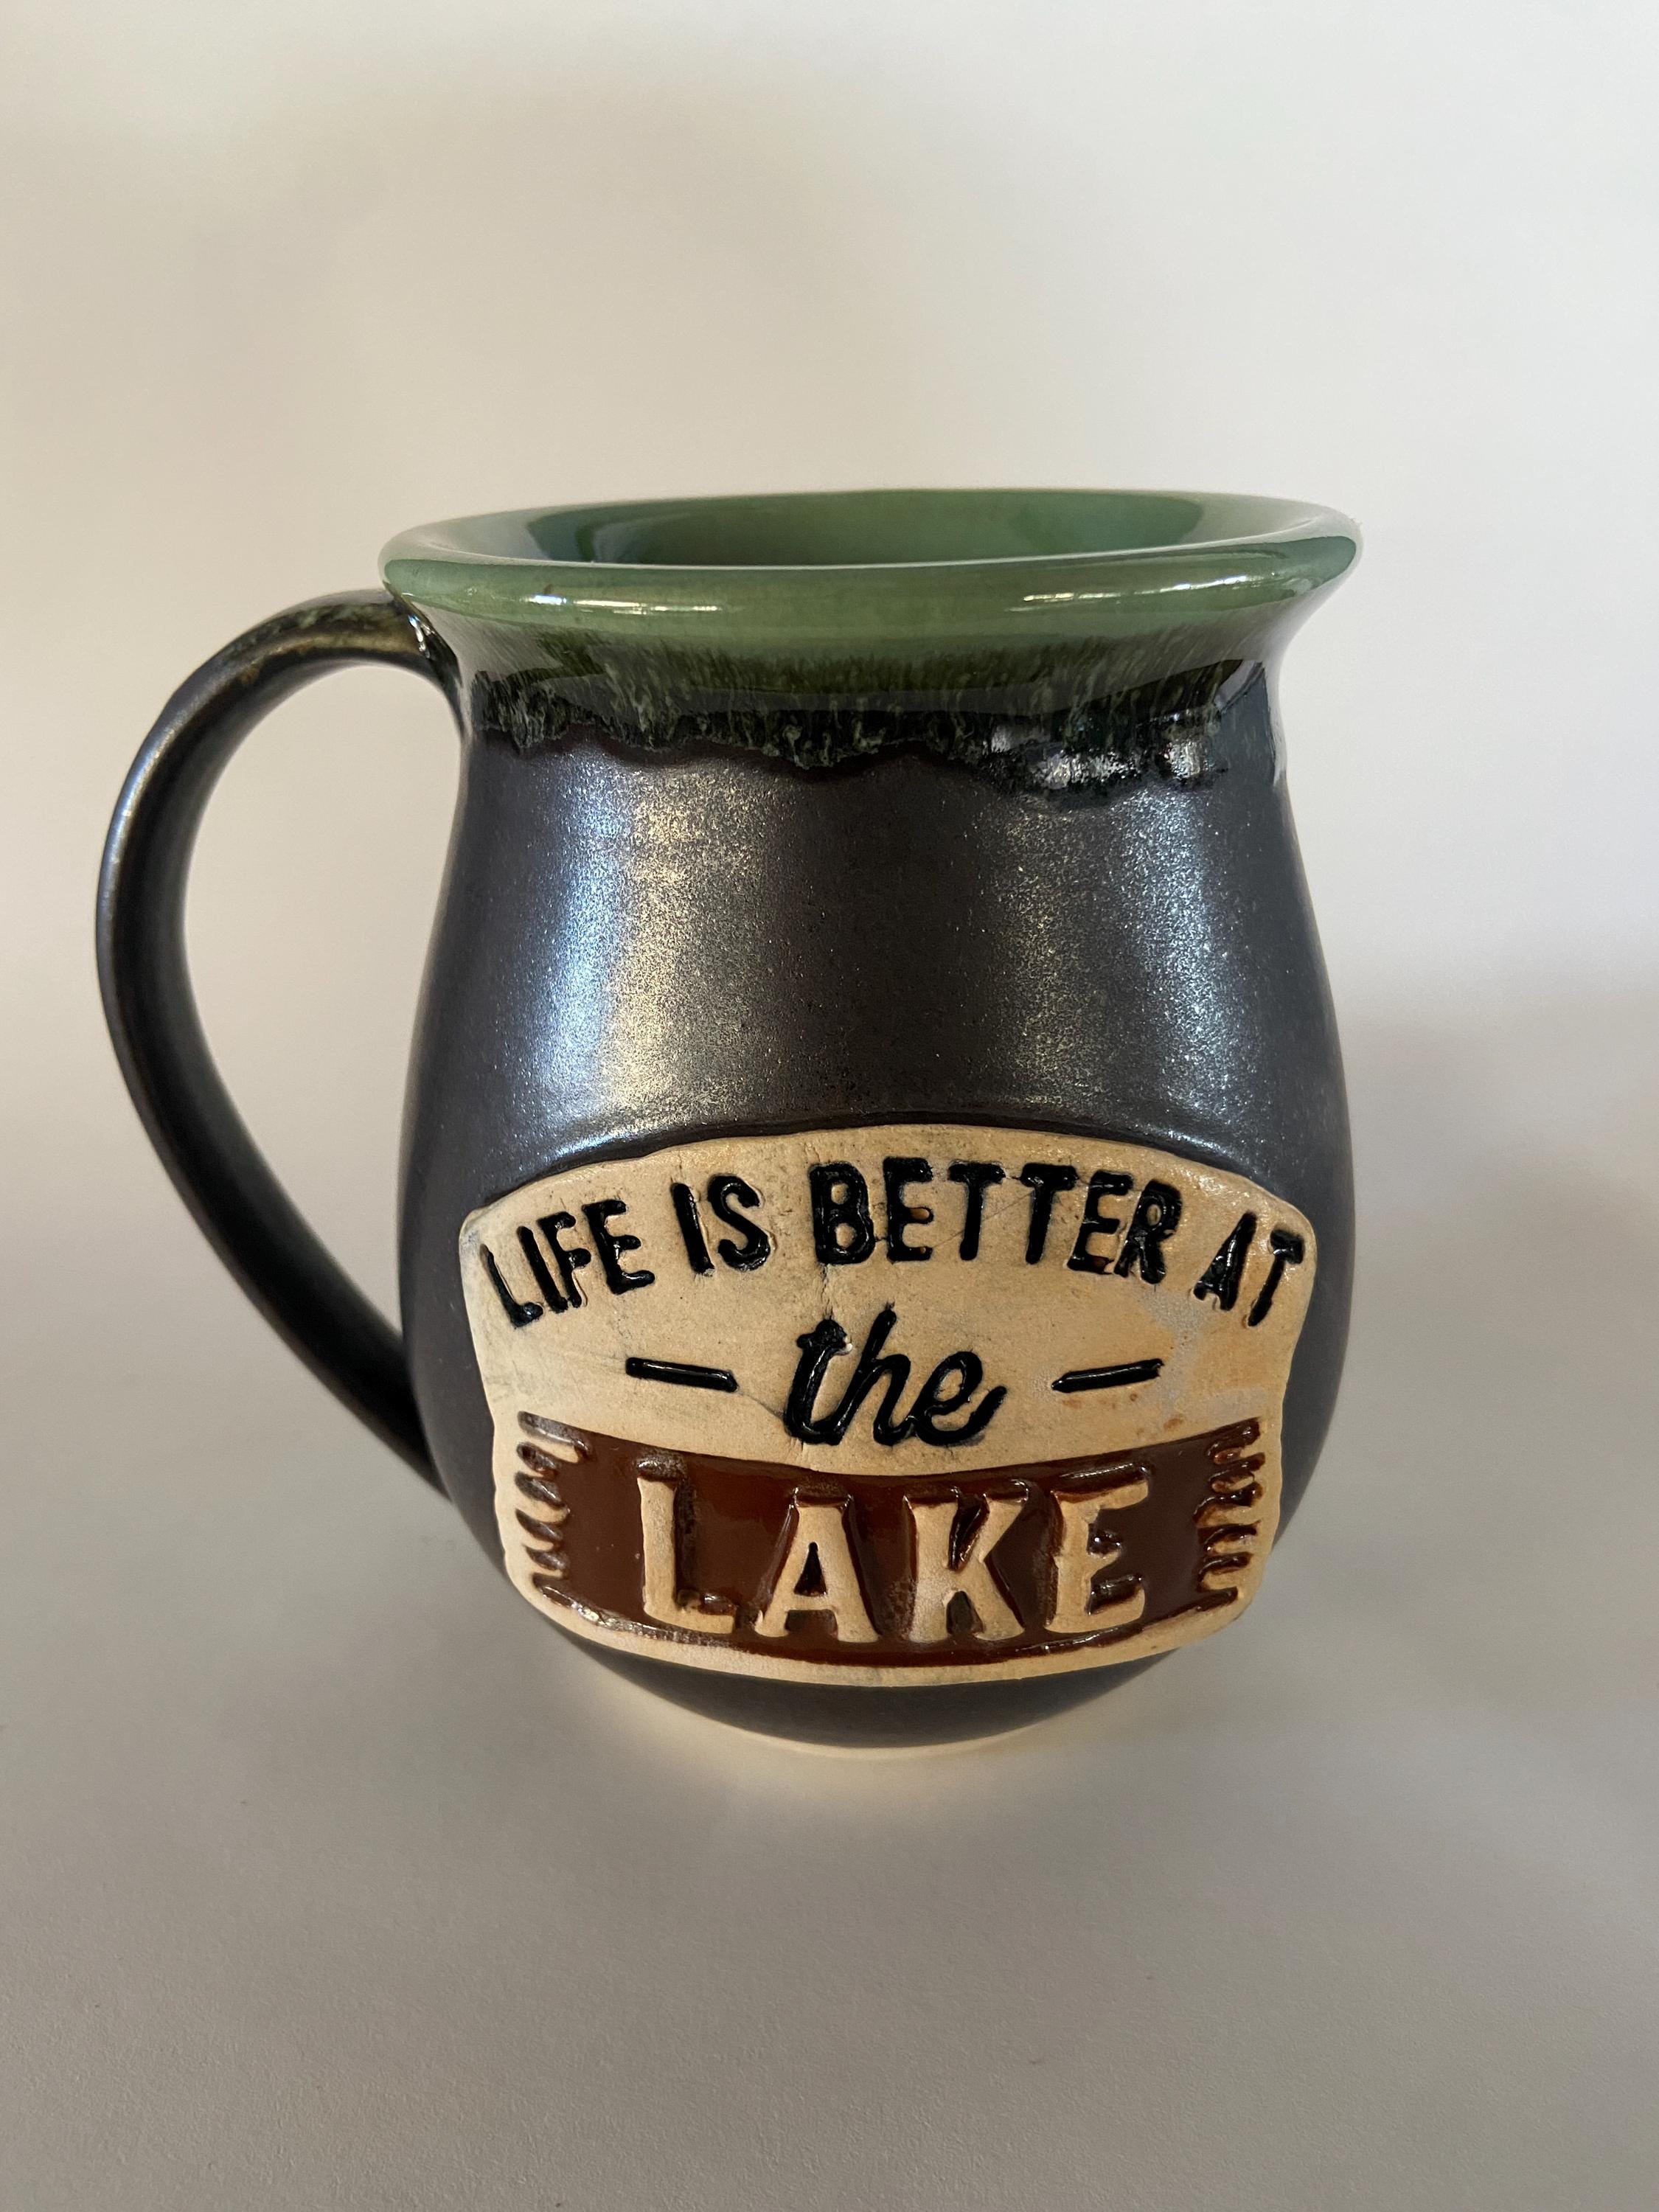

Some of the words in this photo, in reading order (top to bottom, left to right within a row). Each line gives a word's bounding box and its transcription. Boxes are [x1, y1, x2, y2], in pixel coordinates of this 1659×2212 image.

[479, 1198, 655, 1327] LIFE
[672, 1174, 771, 1276] IS
[808, 1156, 1182, 1284] BETTER
[1194, 1211, 1304, 1326] AT
[783, 1304, 1007, 1447] the
[637, 1473, 1152, 1644] LAKE
